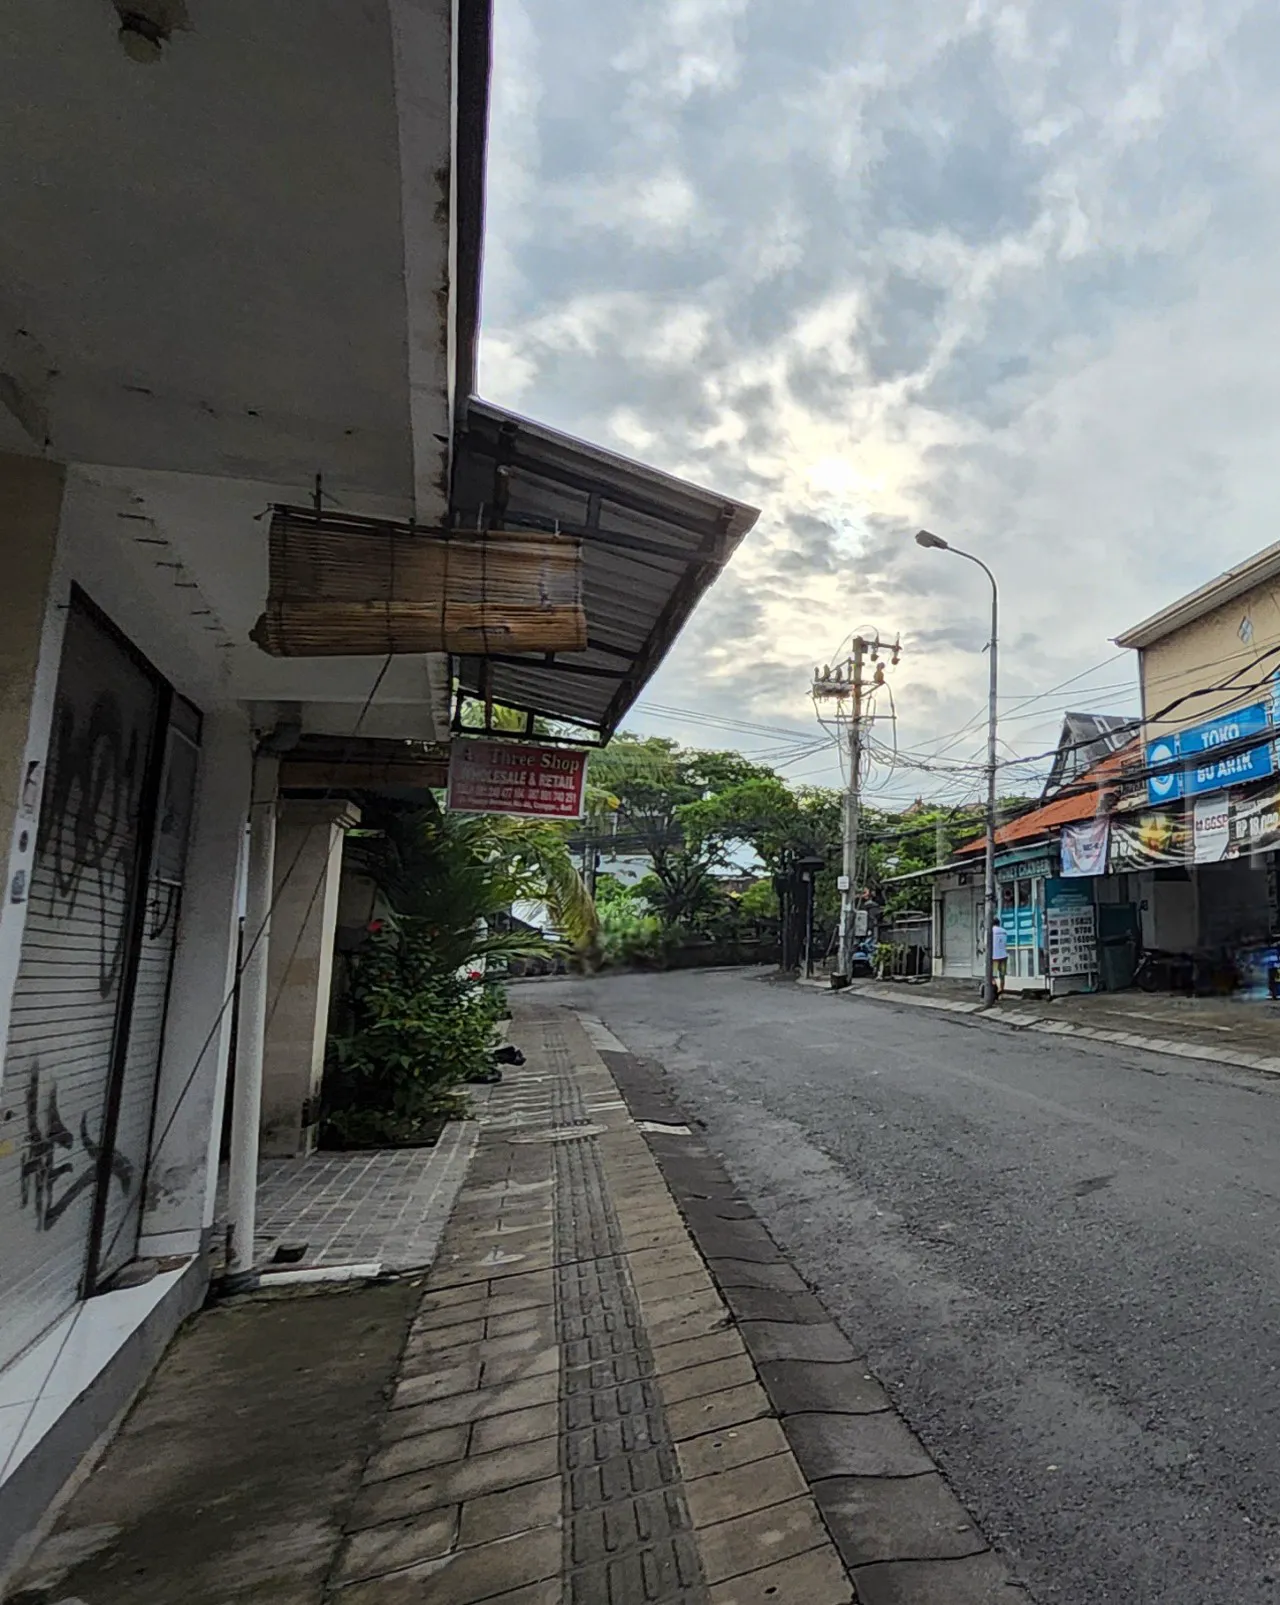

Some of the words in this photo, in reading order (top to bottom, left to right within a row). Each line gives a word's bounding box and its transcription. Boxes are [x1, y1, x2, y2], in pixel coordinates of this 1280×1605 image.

[1201, 724, 1240, 748] TOKO
[488, 748, 536, 766] Three
[540, 752, 580, 774] Shop
[461, 766, 526, 786] WHOLESALE
[528, 773, 536, 786] &
[538, 773, 575, 790] RETAIL
